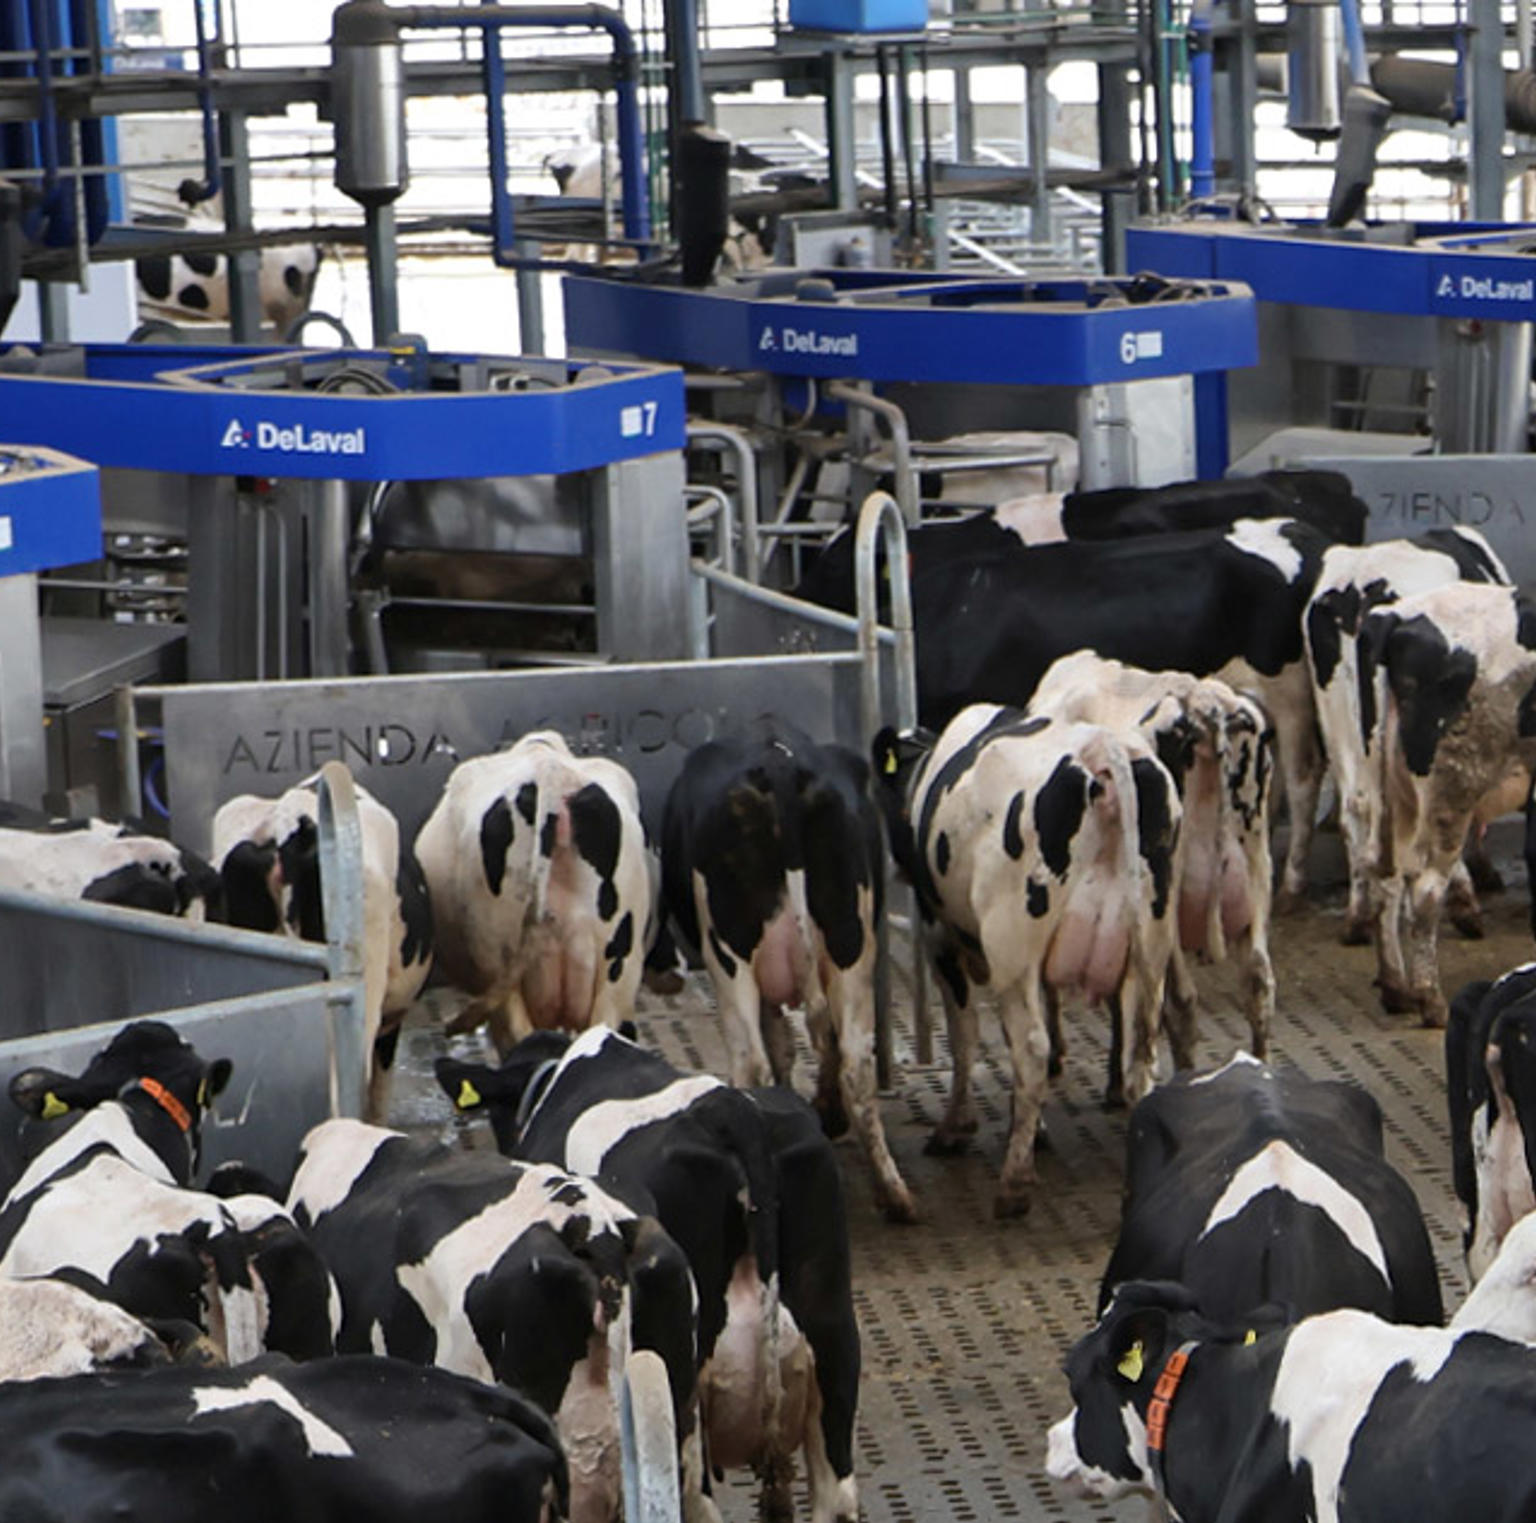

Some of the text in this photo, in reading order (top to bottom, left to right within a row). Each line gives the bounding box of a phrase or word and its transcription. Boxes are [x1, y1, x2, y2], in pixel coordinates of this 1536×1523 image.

[1461, 276, 1533, 300] DeLaval
[782, 328, 857, 355] DeLaval
[1120, 332, 1137, 364] 6
[643, 401, 658, 436] 7
[257, 422, 365, 454] DeLaval
[1378, 492, 1527, 527] ZIENDA
[223, 724, 459, 774] AZIENDA
